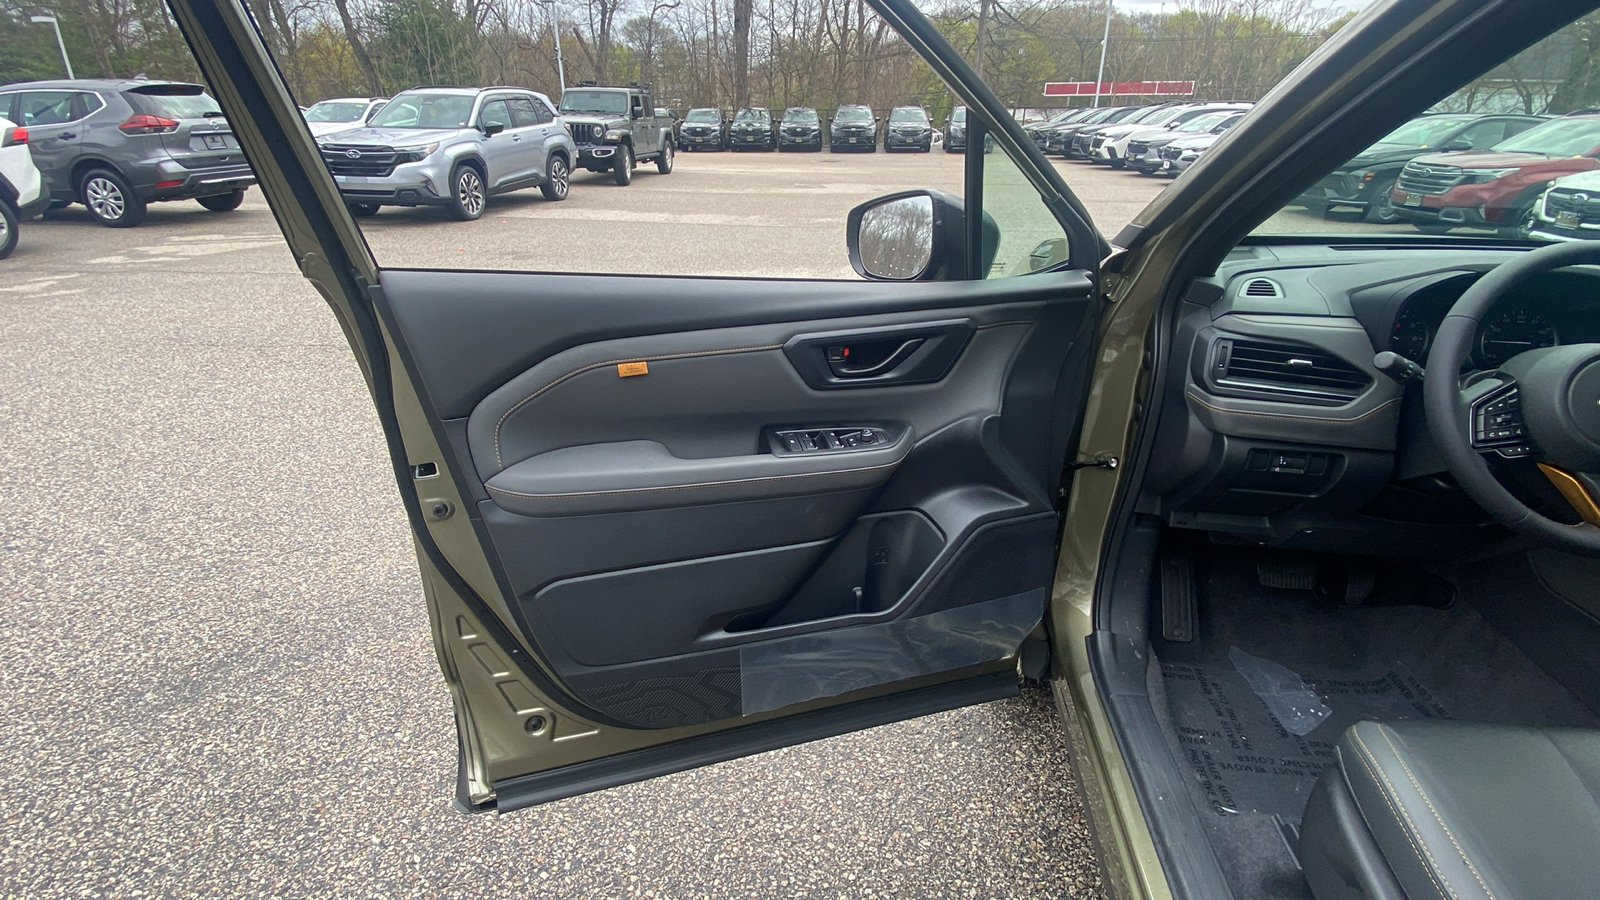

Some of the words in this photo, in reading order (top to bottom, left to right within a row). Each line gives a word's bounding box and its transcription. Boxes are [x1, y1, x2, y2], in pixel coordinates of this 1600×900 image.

[1194, 667, 1213, 695] REMOVE
[1211, 682, 1229, 705] COVER
[1208, 698, 1224, 717] MUST
[1180, 727, 1222, 738] REMOVE
[1221, 720, 1241, 749] DEALER
[1225, 708, 1253, 750] PROTECTIVE
[1219, 762, 1266, 773] REMOVE
[1236, 754, 1274, 764] COVER
[1189, 749, 1217, 797] PROTECTIVE
[1202, 750, 1222, 780] DEALER
[1217, 785, 1237, 808] MUST
[1273, 768, 1304, 776] MUST
